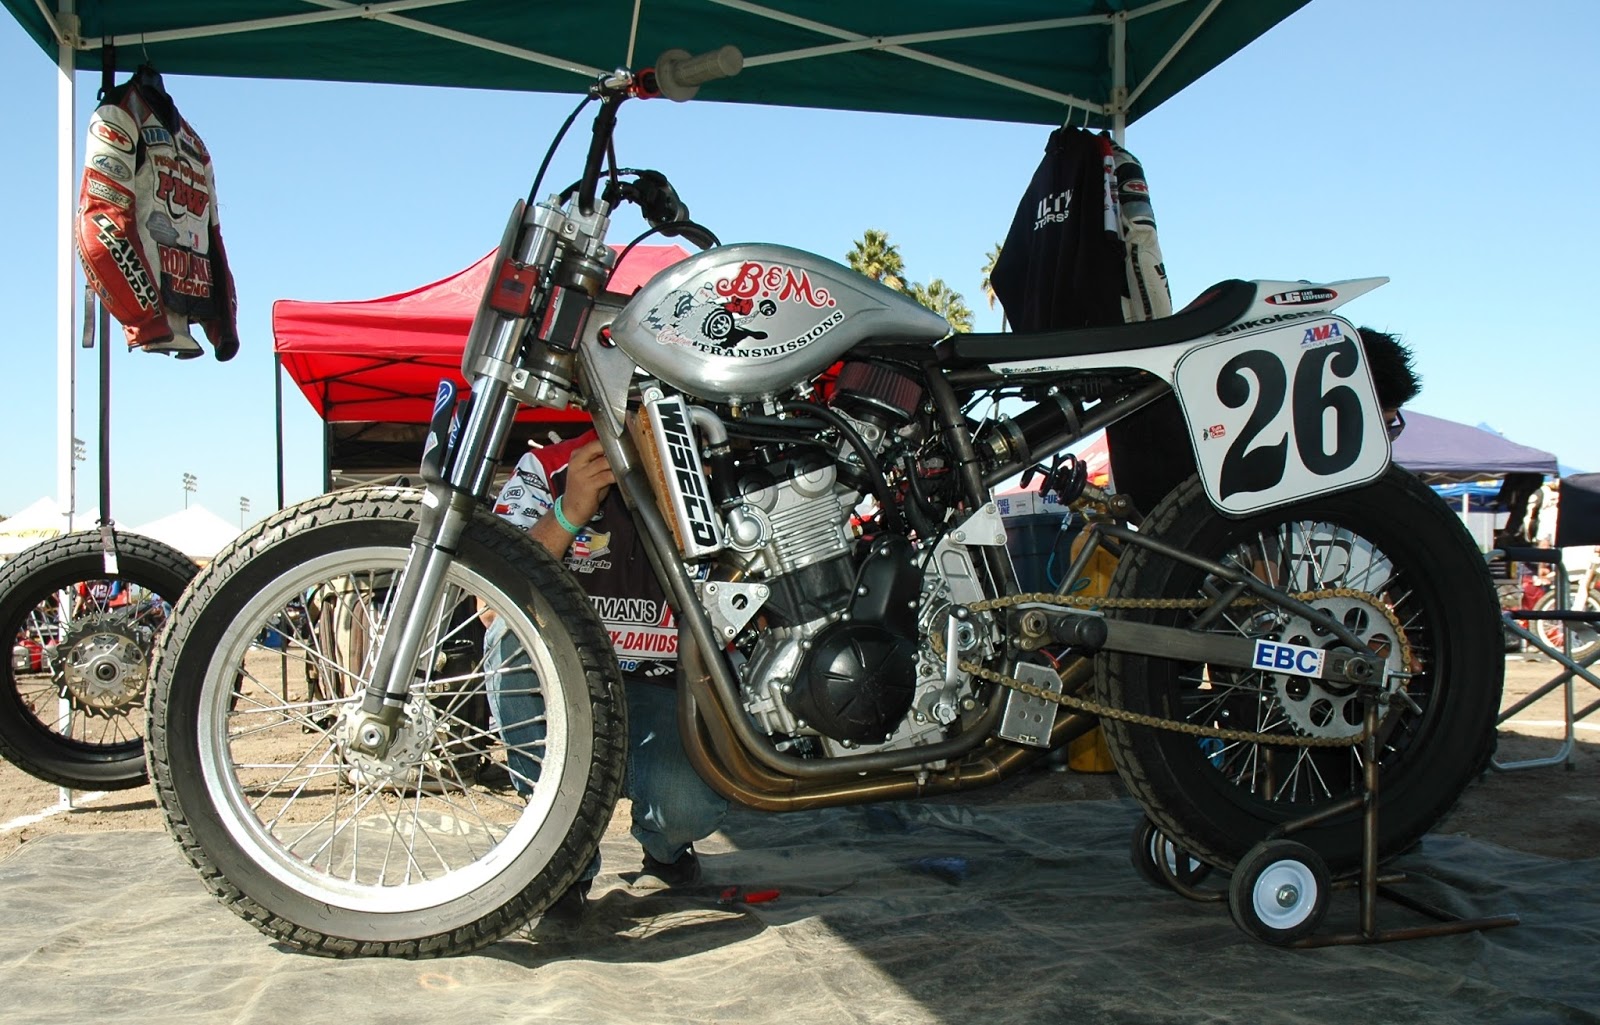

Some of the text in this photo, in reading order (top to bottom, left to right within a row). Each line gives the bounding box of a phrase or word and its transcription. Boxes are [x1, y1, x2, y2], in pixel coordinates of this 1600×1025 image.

[92, 213, 161, 317] LAWSON
[97, 232, 148, 310] HONDA
[159, 245, 188, 280] ROD
[171, 277, 210, 298] RACING
[1274, 292, 1301, 304] LG
[697, 310, 845, 359] TRANSMISSIONS
[1300, 323, 1342, 345] AMA
[1216, 334, 1364, 502] 26
[657, 402, 718, 548] WISECO
[1042, 494, 1057, 504] FUE
[589, 596, 657, 623] MAN'S
[607, 630, 678, 653] Y-DAVIDS
[1255, 642, 1318, 673] EBC
